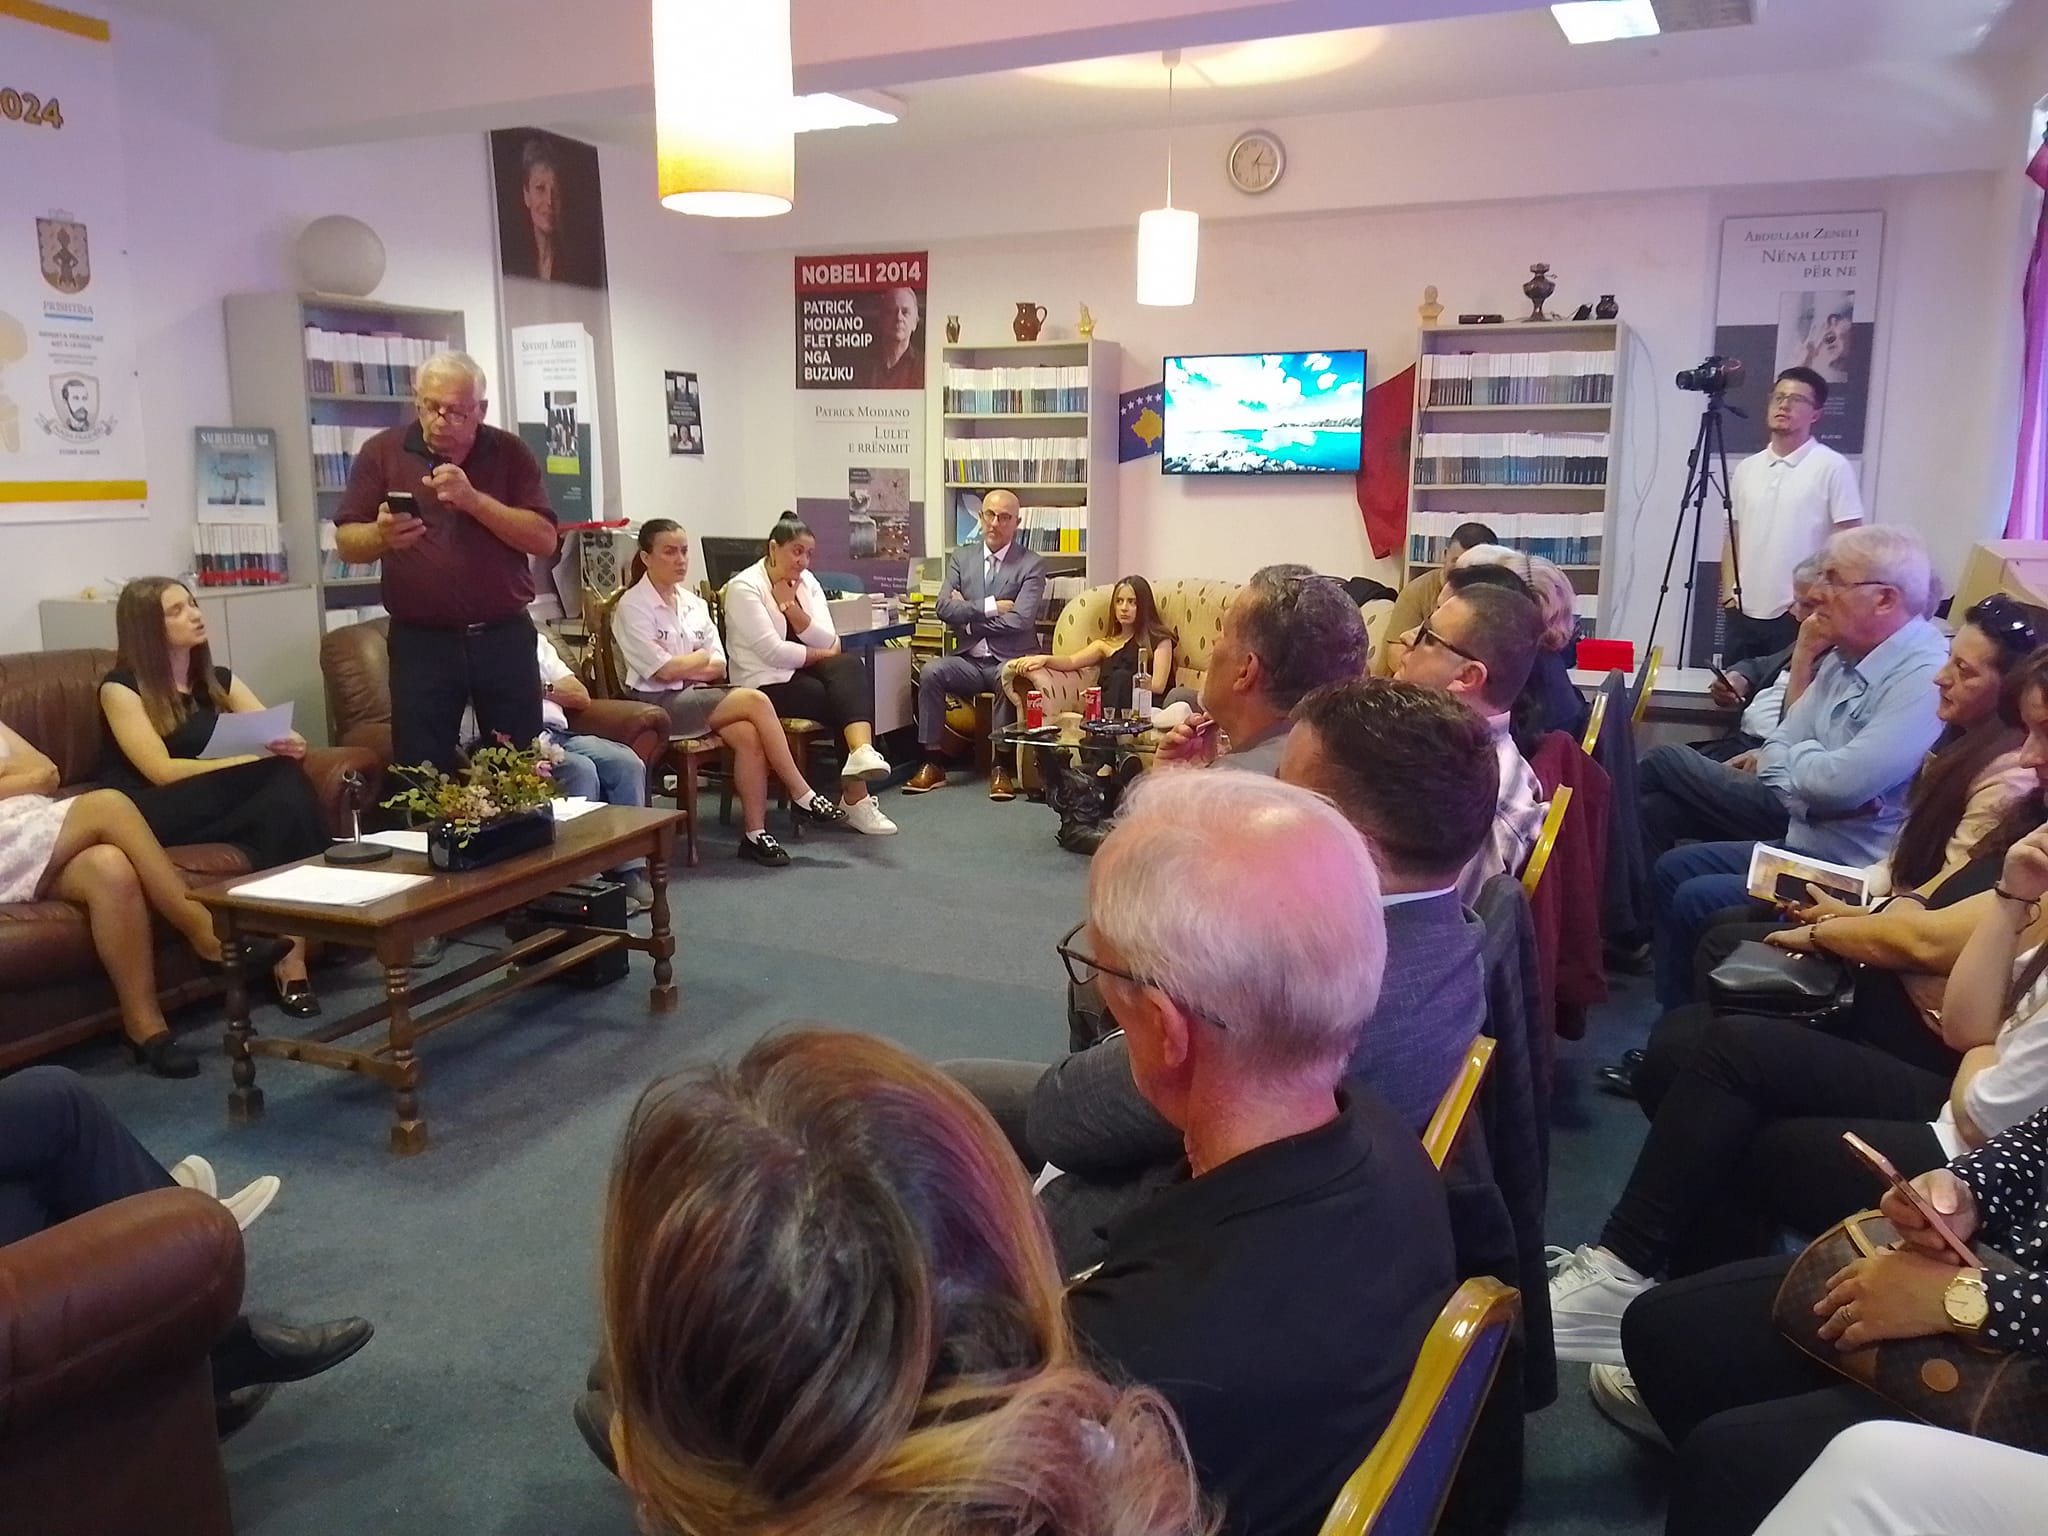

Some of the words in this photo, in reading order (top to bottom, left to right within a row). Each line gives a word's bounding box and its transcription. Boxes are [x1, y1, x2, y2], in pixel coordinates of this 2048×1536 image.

[0, 86, 64, 130] 024
[1744, 231, 1809, 241] ABDULLAH
[1813, 228, 1859, 239] ZENELI
[802, 263, 871, 284] NOBELI
[875, 261, 921, 282] 2014
[1803, 265, 1832, 278] PËR
[1837, 266, 1857, 277] NE
[803, 300, 854, 314] PATRICK
[804, 316, 864, 331] MODIANO
[804, 334, 833, 348] FLET
[835, 333, 873, 347] SHQIP
[804, 350, 832, 364] NGA
[804, 366, 854, 381] BUZUKU
[815, 406, 855, 417] PATRICK
[858, 406, 910, 417] MODIANO
[874, 425, 910, 439] LULET
